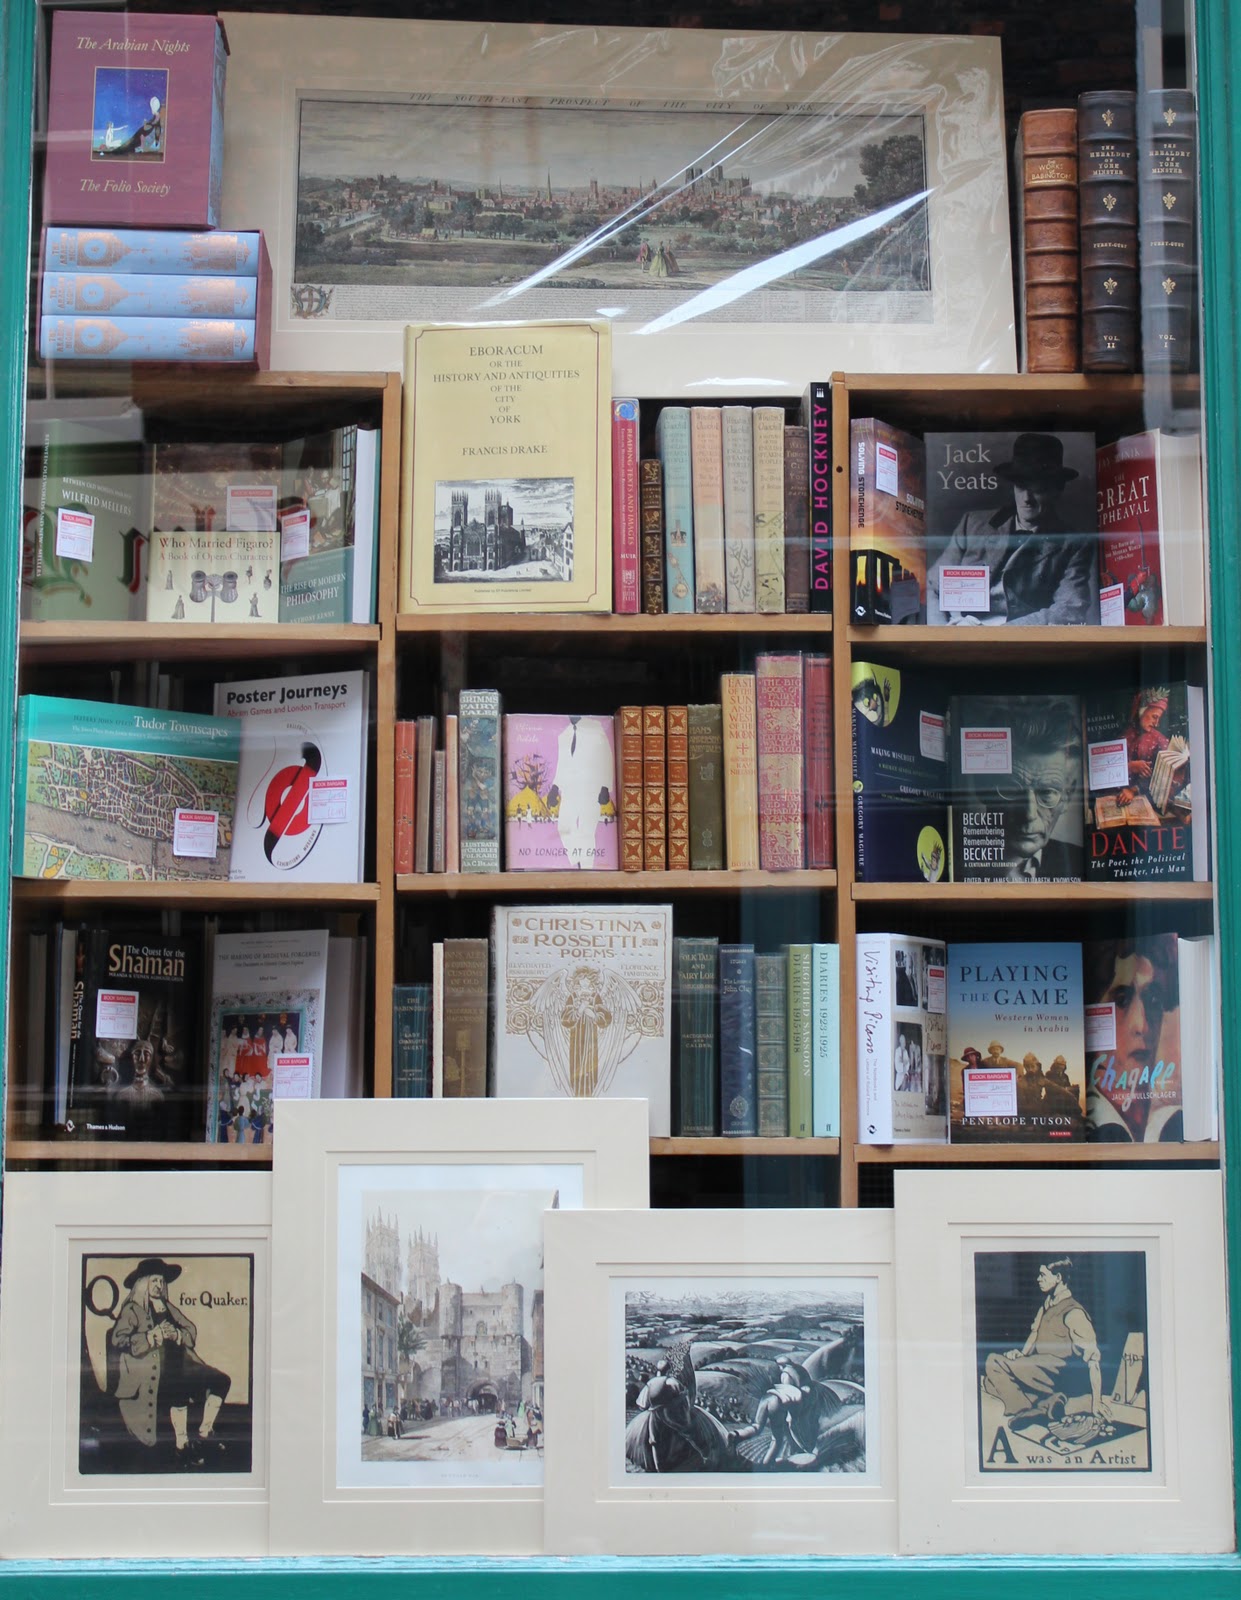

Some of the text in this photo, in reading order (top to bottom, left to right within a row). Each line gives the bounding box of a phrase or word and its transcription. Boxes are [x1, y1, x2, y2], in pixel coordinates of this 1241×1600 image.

[76, 37, 190, 55] The Arabian Nights
[80, 179, 171, 196] The Folio Society
[469, 345, 543, 356] EBORACUM
[433, 370, 580, 382] HISTORY AND ANTIQUITIES
[490, 415, 521, 424] YORK
[462, 445, 548, 456] FRANCIS DRAKE
[944, 443, 991, 468] Jack
[937, 471, 998, 491] Yeats
[62, 489, 100, 506] WILFRID
[101, 500, 131, 515] MELLERS
[814, 405, 828, 590] DAVID HOCKNEY
[1097, 476, 1150, 512] GREAT
[1098, 500, 1150, 527] PHEAVAL
[159, 537, 274, 551] Who Married Figaro?
[159, 552, 273, 563] A Book of Opera Characters
[281, 573, 346, 594] THE RISE OF MODERN
[286, 586, 339, 607] PHILOSOPHY
[728, 679, 752, 688] EAST
[227, 684, 347, 705] Poster Journeys
[461, 695, 499, 704] GRIMMS
[730, 696, 753, 704] SUN
[228, 701, 346, 718] Abram Games and London Transport
[729, 714, 753, 722] WEST
[134, 715, 167, 731] Tudor
[169, 720, 228, 739] Townscapes
[963, 812, 1005, 826] BECKETT
[963, 827, 1005, 837] Remembering
[963, 837, 1005, 847] Remembering
[1091, 826, 1186, 858] DANTE
[518, 847, 606, 857] NO LONGER AT EASE
[963, 847, 1005, 861] BECKETT
[1091, 860, 1105, 868] The
[1131, 856, 1144, 865] the
[1147, 853, 1186, 863] Political
[1151, 866, 1164, 874] the
[524, 917, 648, 933] CHRISTINA
[128, 945, 186, 958] The Quest for the
[560, 949, 615, 959] POEMS
[108, 944, 185, 977] Shaman
[859, 951, 883, 1003] Visiting
[960, 965, 1069, 982] PLAYING
[723, 986, 738, 994] John
[960, 988, 1069, 1005] THE GAME
[71, 981, 84, 1039] Shaman
[820, 952, 828, 1058] DIARIES 1923-1925
[995, 1013, 1069, 1021] Western Women
[793, 1007, 801, 1053] 1915-1918
[864, 1010, 883, 1054] Picasso
[1090, 1054, 1176, 1112] Chagall
[962, 1117, 1072, 1126] PENELOPE TUSON
[84, 1274, 119, 1321] Q
[179, 1293, 197, 1306] for
[986, 1426, 1137, 1464] A was an Artist
